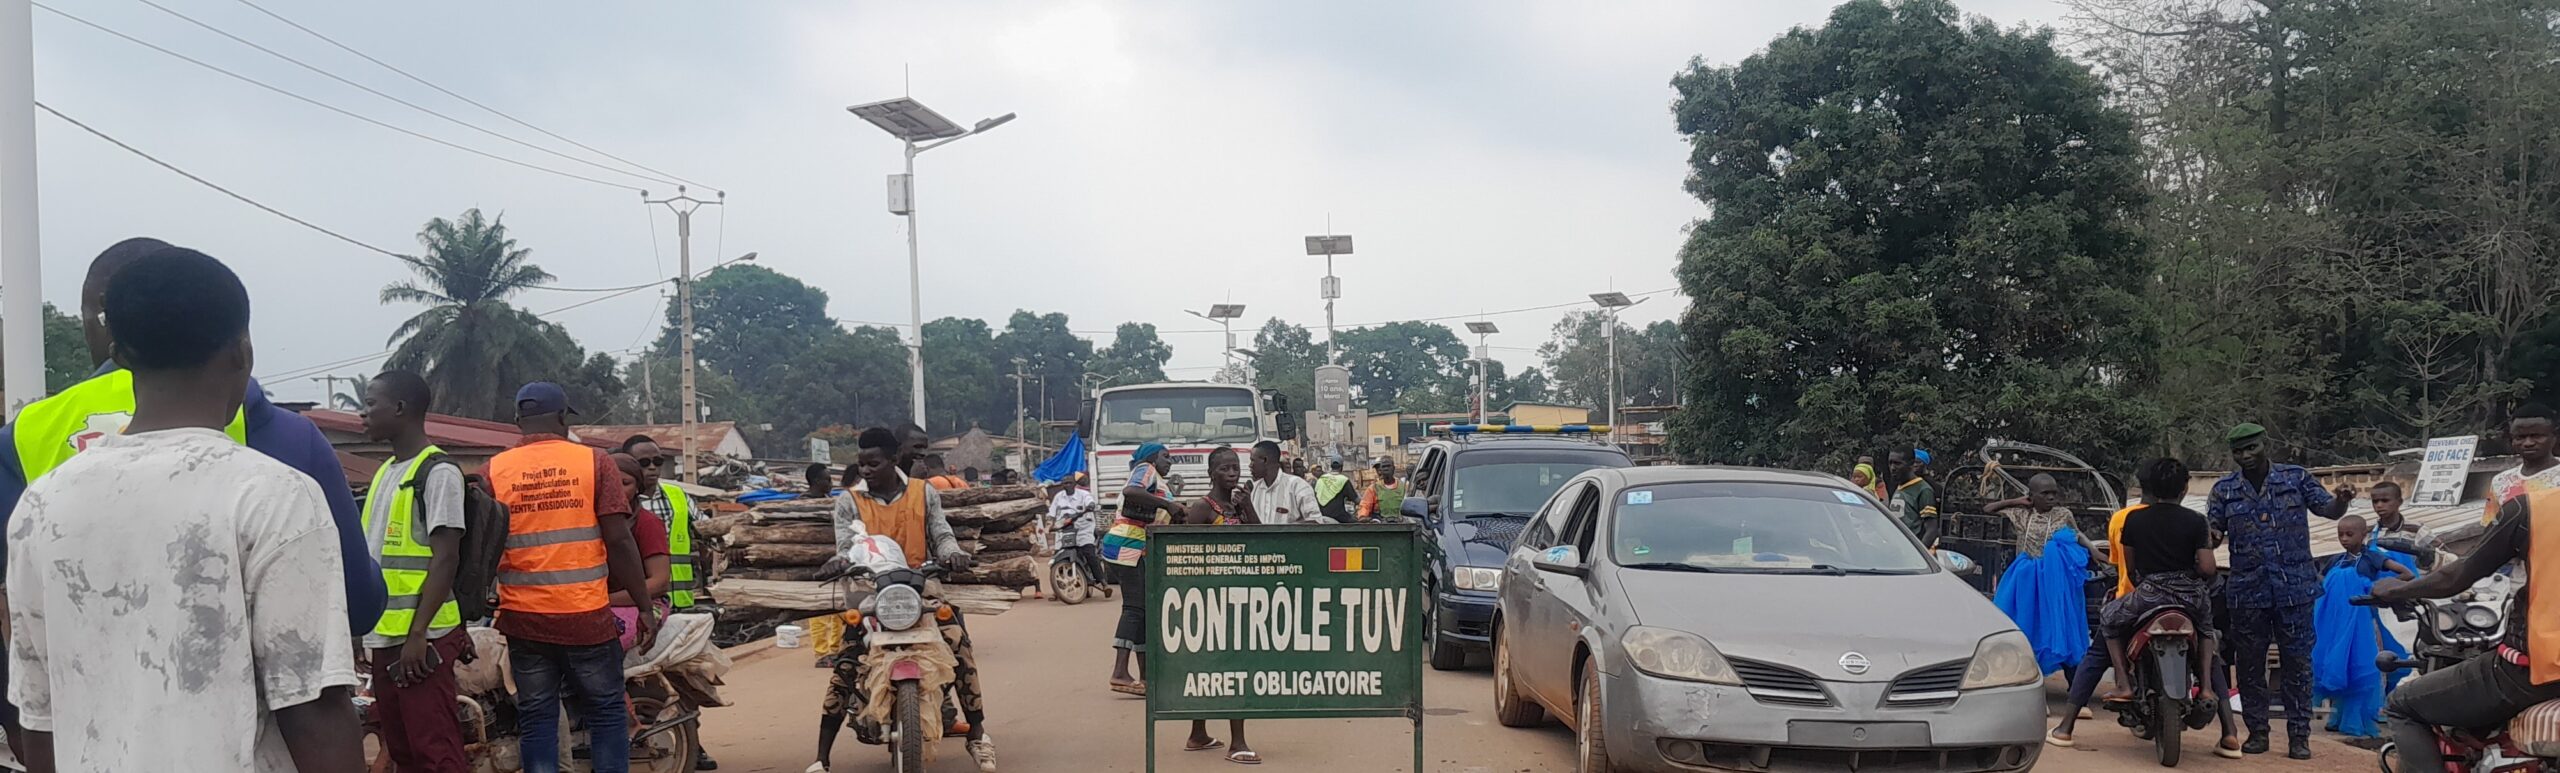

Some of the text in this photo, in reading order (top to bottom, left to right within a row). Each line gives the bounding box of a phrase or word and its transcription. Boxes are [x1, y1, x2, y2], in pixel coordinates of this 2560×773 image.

[2427, 448, 2469, 462] BIG FACE
[522, 471, 542, 481] Projet
[543, 468, 556, 477] BOT
[572, 477, 579, 485] et
[521, 489, 571, 502] Immatriculation
[510, 498, 584, 514] CENTRE KISSIDOUGOU
[1166, 544, 1246, 553] MINISTERE DU BUDGET
[1166, 553, 1286, 564] DIRECTION GENERALE DES IMPÔTS
[1166, 564, 1303, 575] DIRECTION PREFECTORALE DES IMPÔTS
[1161, 581, 1407, 653] CONTRÔLE TUV
[1183, 670, 1383, 697] ARRET OBLIGATOIRE
